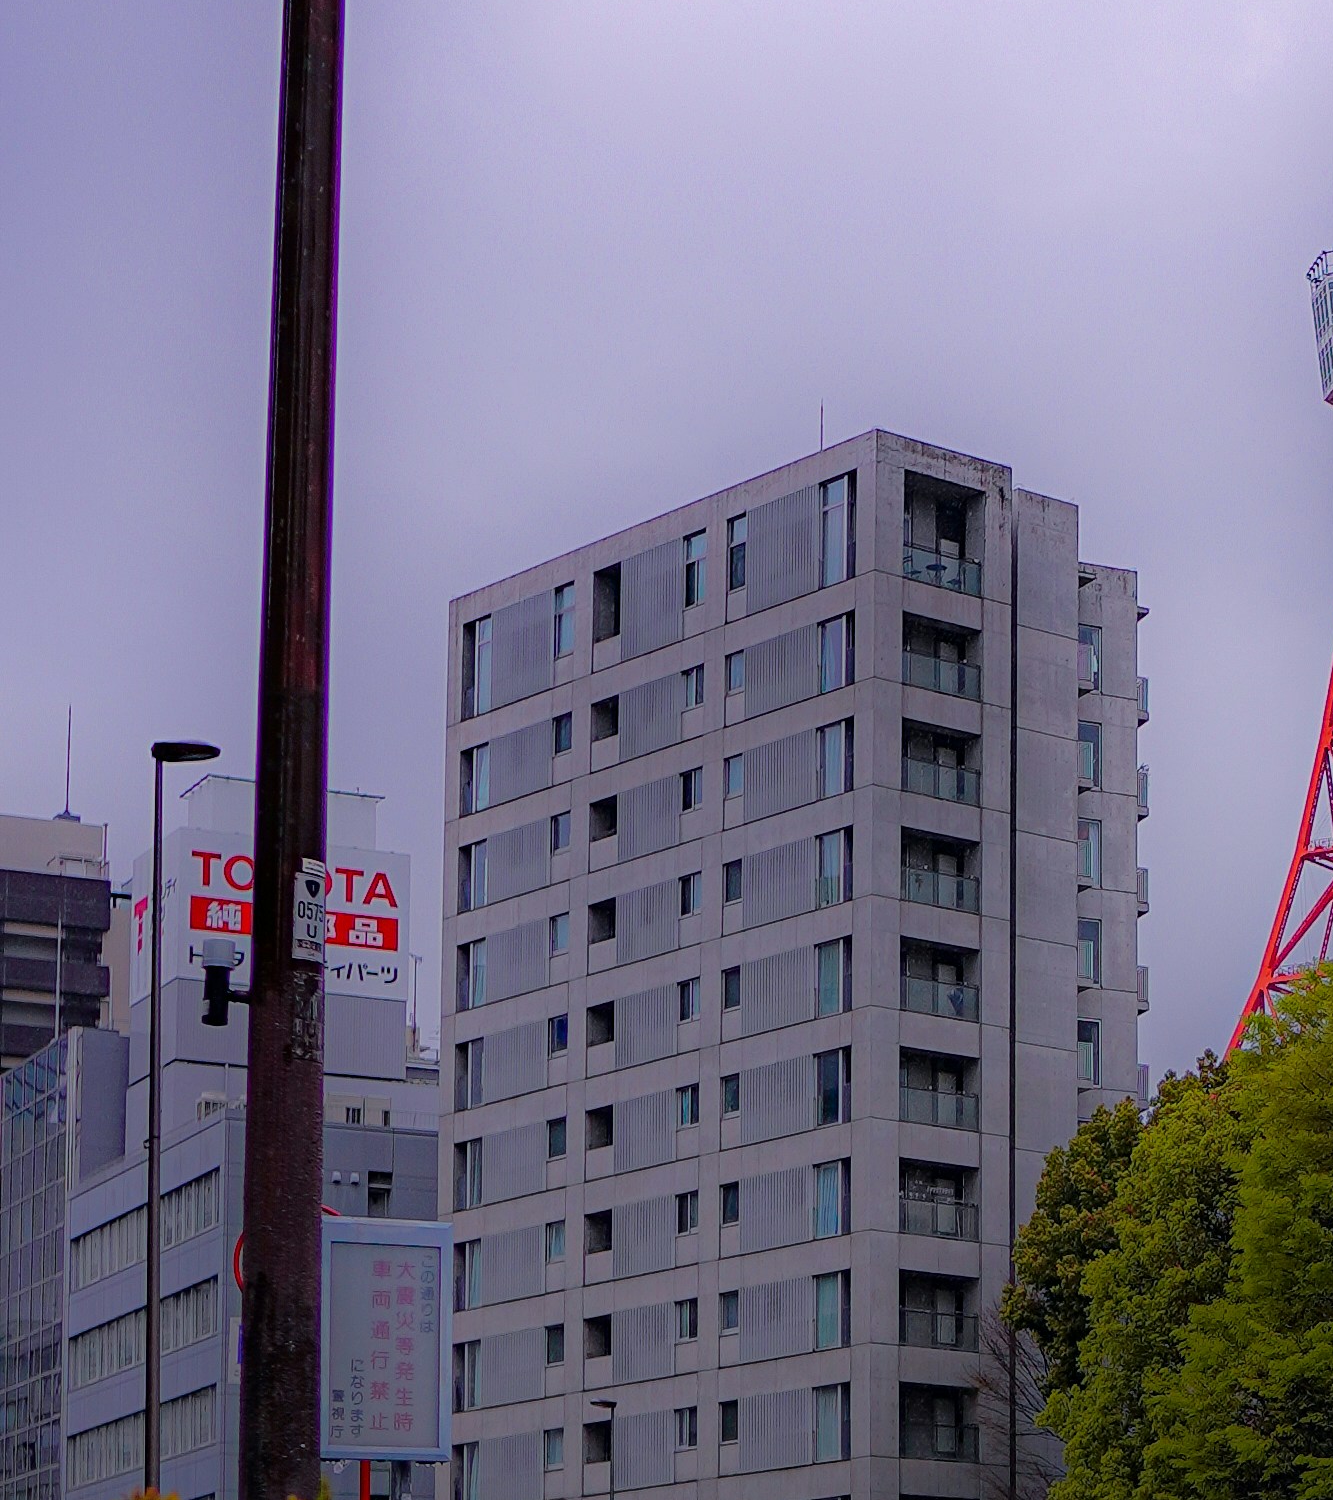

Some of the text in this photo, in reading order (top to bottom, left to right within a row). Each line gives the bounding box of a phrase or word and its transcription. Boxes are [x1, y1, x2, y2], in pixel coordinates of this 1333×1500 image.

[191, 850, 399, 909] TOTA
[420, 1254, 436, 1334] この通りは
[369, 1259, 391, 1432] 車両通行禁止
[393, 1260, 416, 1432] 大震災等発生時
[330, 1389, 345, 1439] 警視庁
[350, 1359, 366, 1439] になります
